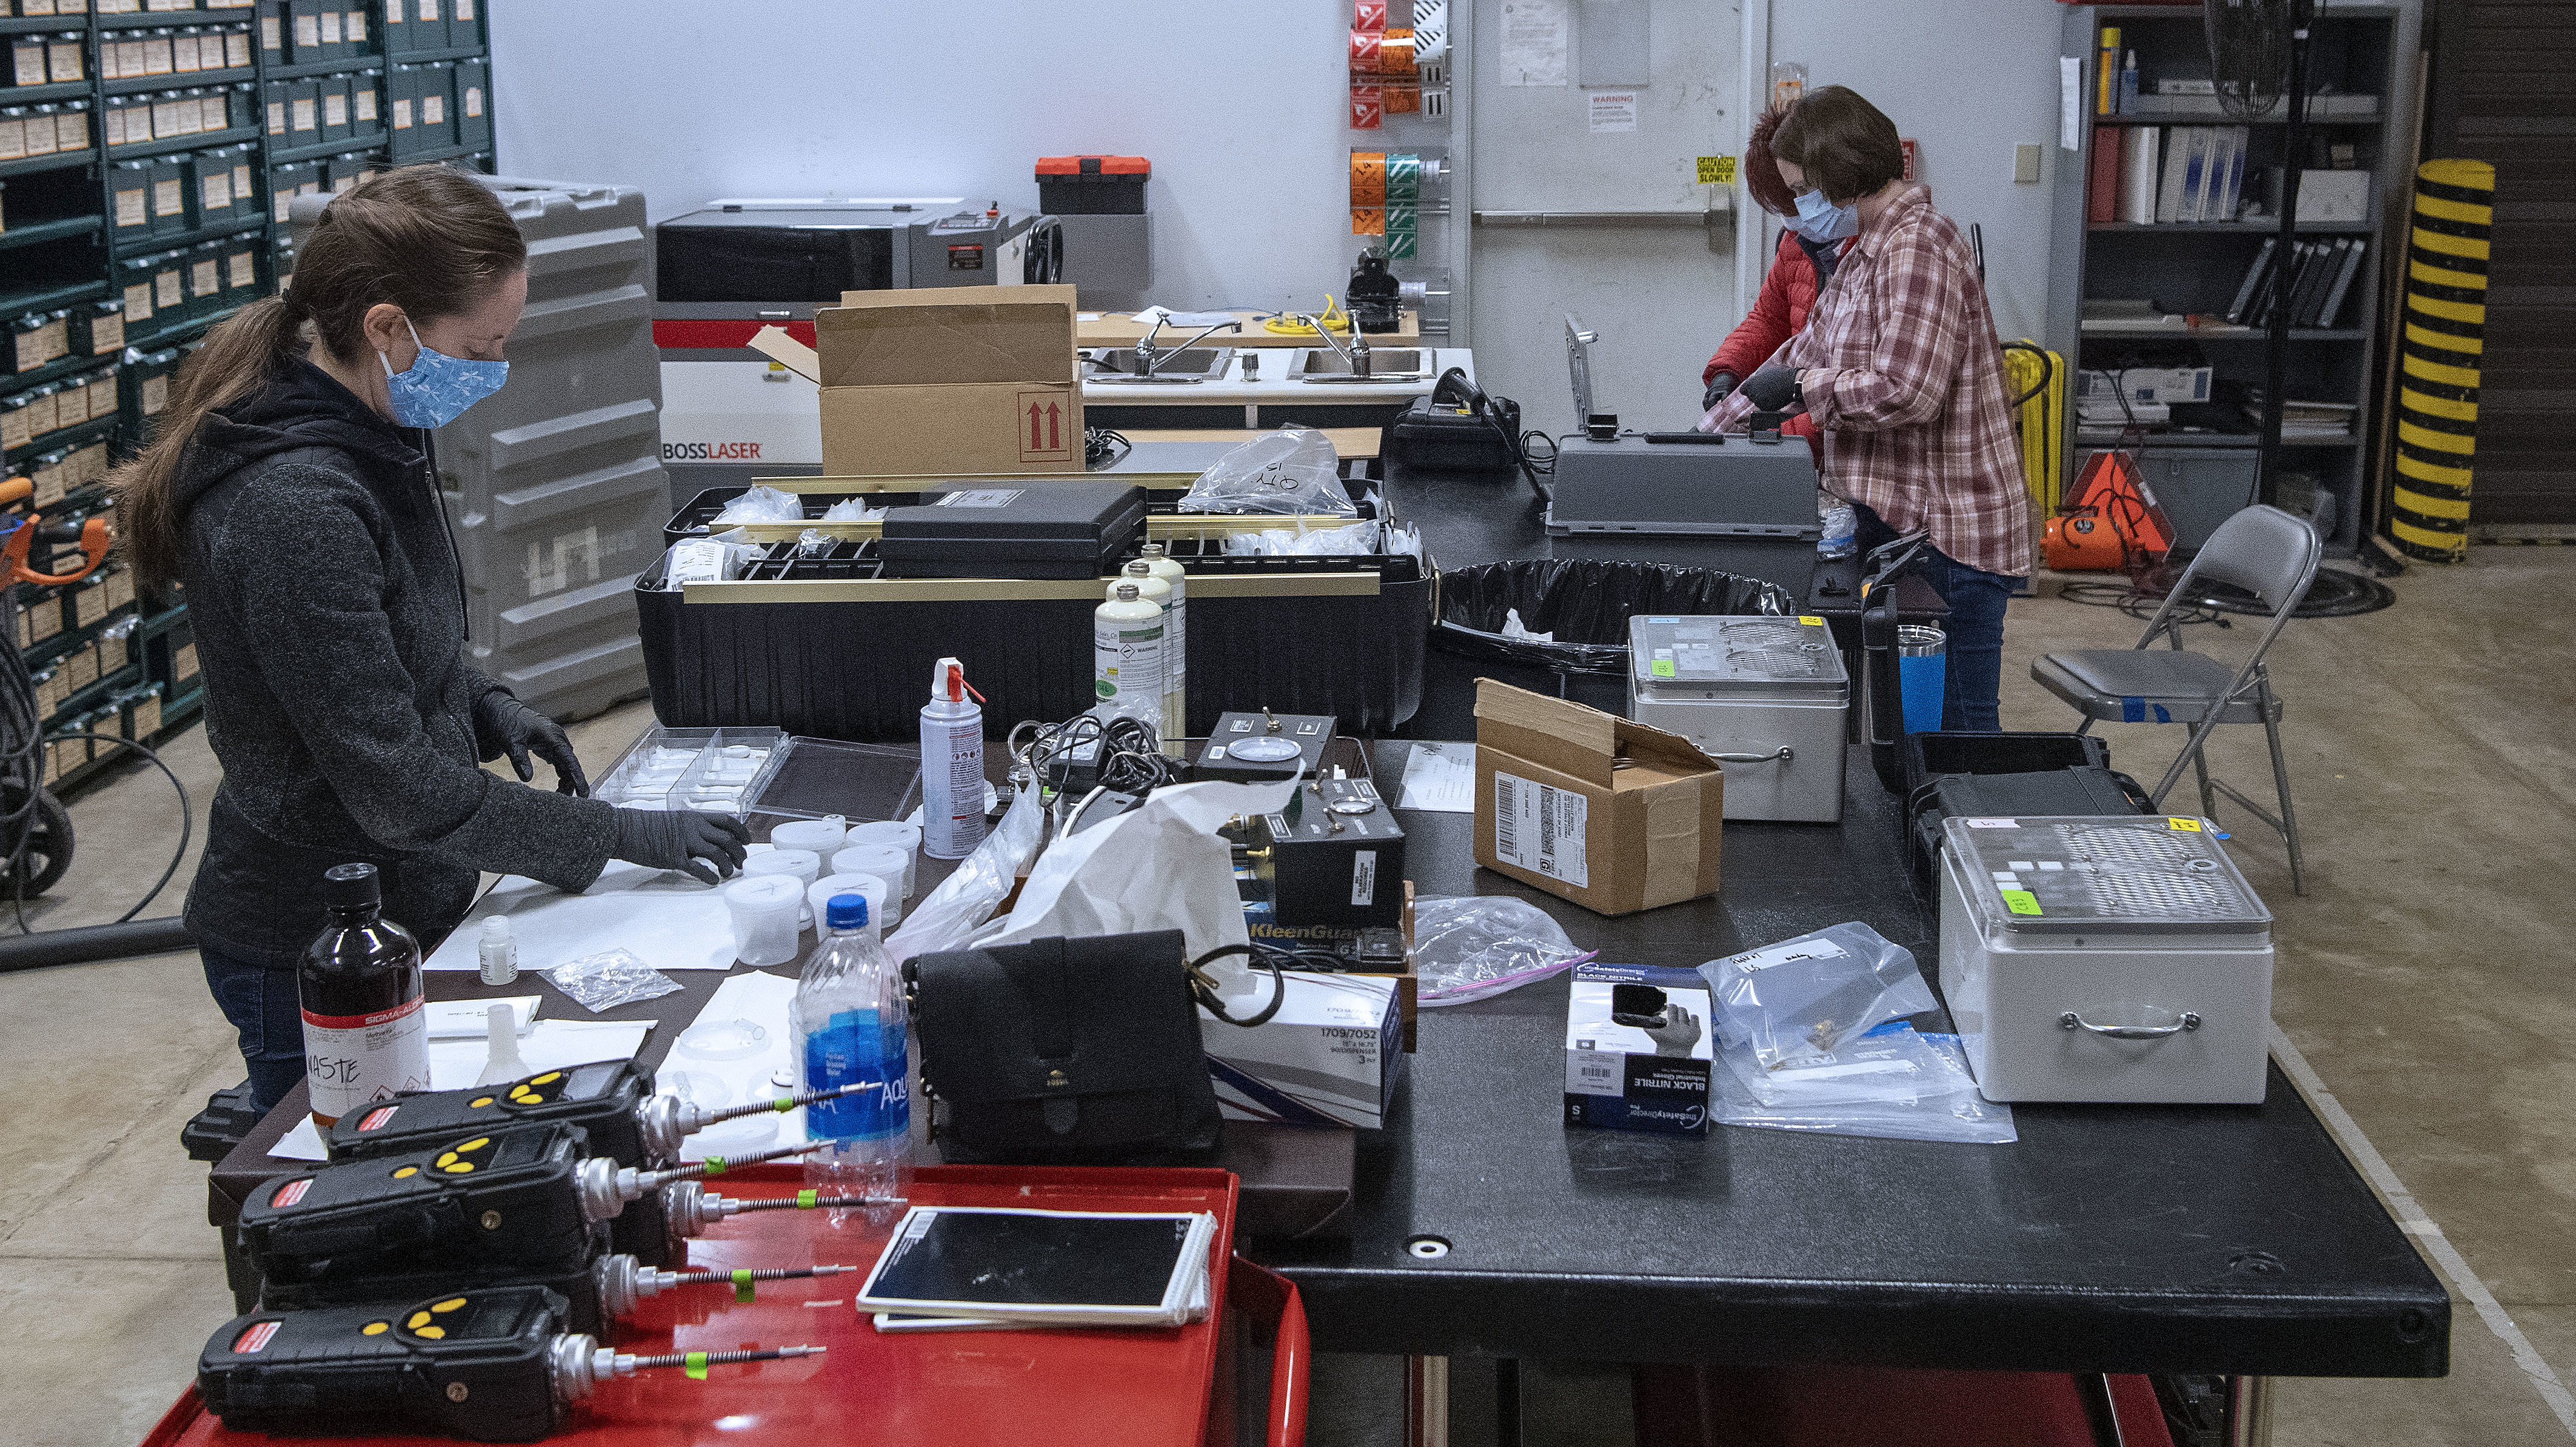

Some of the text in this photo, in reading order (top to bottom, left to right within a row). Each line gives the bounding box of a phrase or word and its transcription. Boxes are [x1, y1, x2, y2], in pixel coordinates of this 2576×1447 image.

[1698, 157, 1735, 166] CAUTION
[1699, 174, 1732, 182] SLOWLY!
[662, 442, 761, 459] BOSSLASER
[1256, 473, 1299, 491] QTY
[1250, 923, 1364, 940] KleenGuar
[1321, 1028, 1377, 1039] 1709/7052
[1359, 1055, 1366, 1064] 3
[1653, 1072, 1675, 1080] Gloves
[1634, 1077, 1705, 1092] BLACK NITRILE
[1571, 1104, 1582, 1115] S
